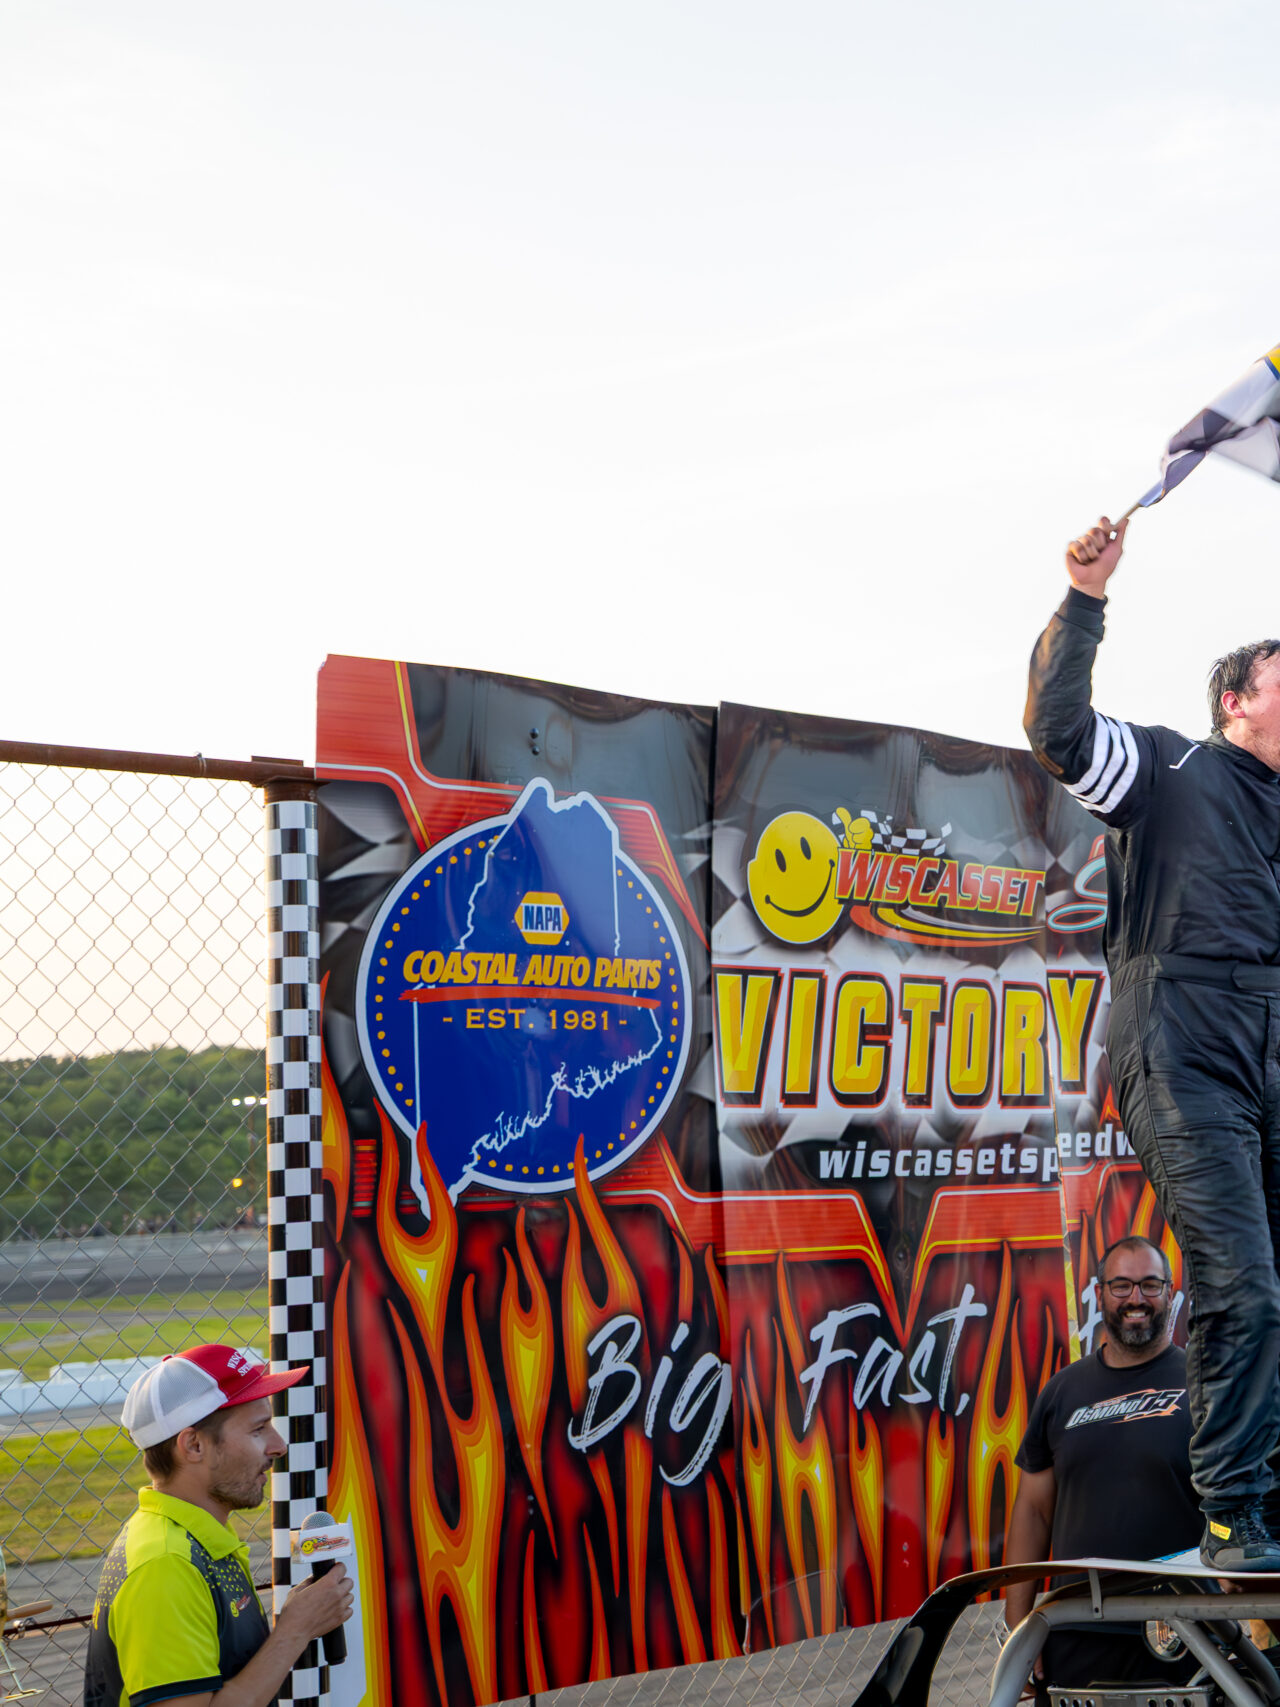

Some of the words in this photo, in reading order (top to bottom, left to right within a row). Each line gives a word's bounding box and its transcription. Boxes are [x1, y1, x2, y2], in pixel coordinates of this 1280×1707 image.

[834, 848, 1047, 917] WISCASSET
[523, 904, 562, 932] NAPA
[402, 950, 519, 984] COASTAL
[522, 954, 591, 987] AUTO
[593, 957, 662, 989] PARTS
[465, 1008, 535, 1029] EST.
[549, 1010, 609, 1031] 1981
[712, 964, 1105, 1108] VICTORY
[567, 1315, 733, 1486] Big
[800, 1283, 988, 1432] Fast,
[1064, 1399, 1145, 1430] OSMOND
